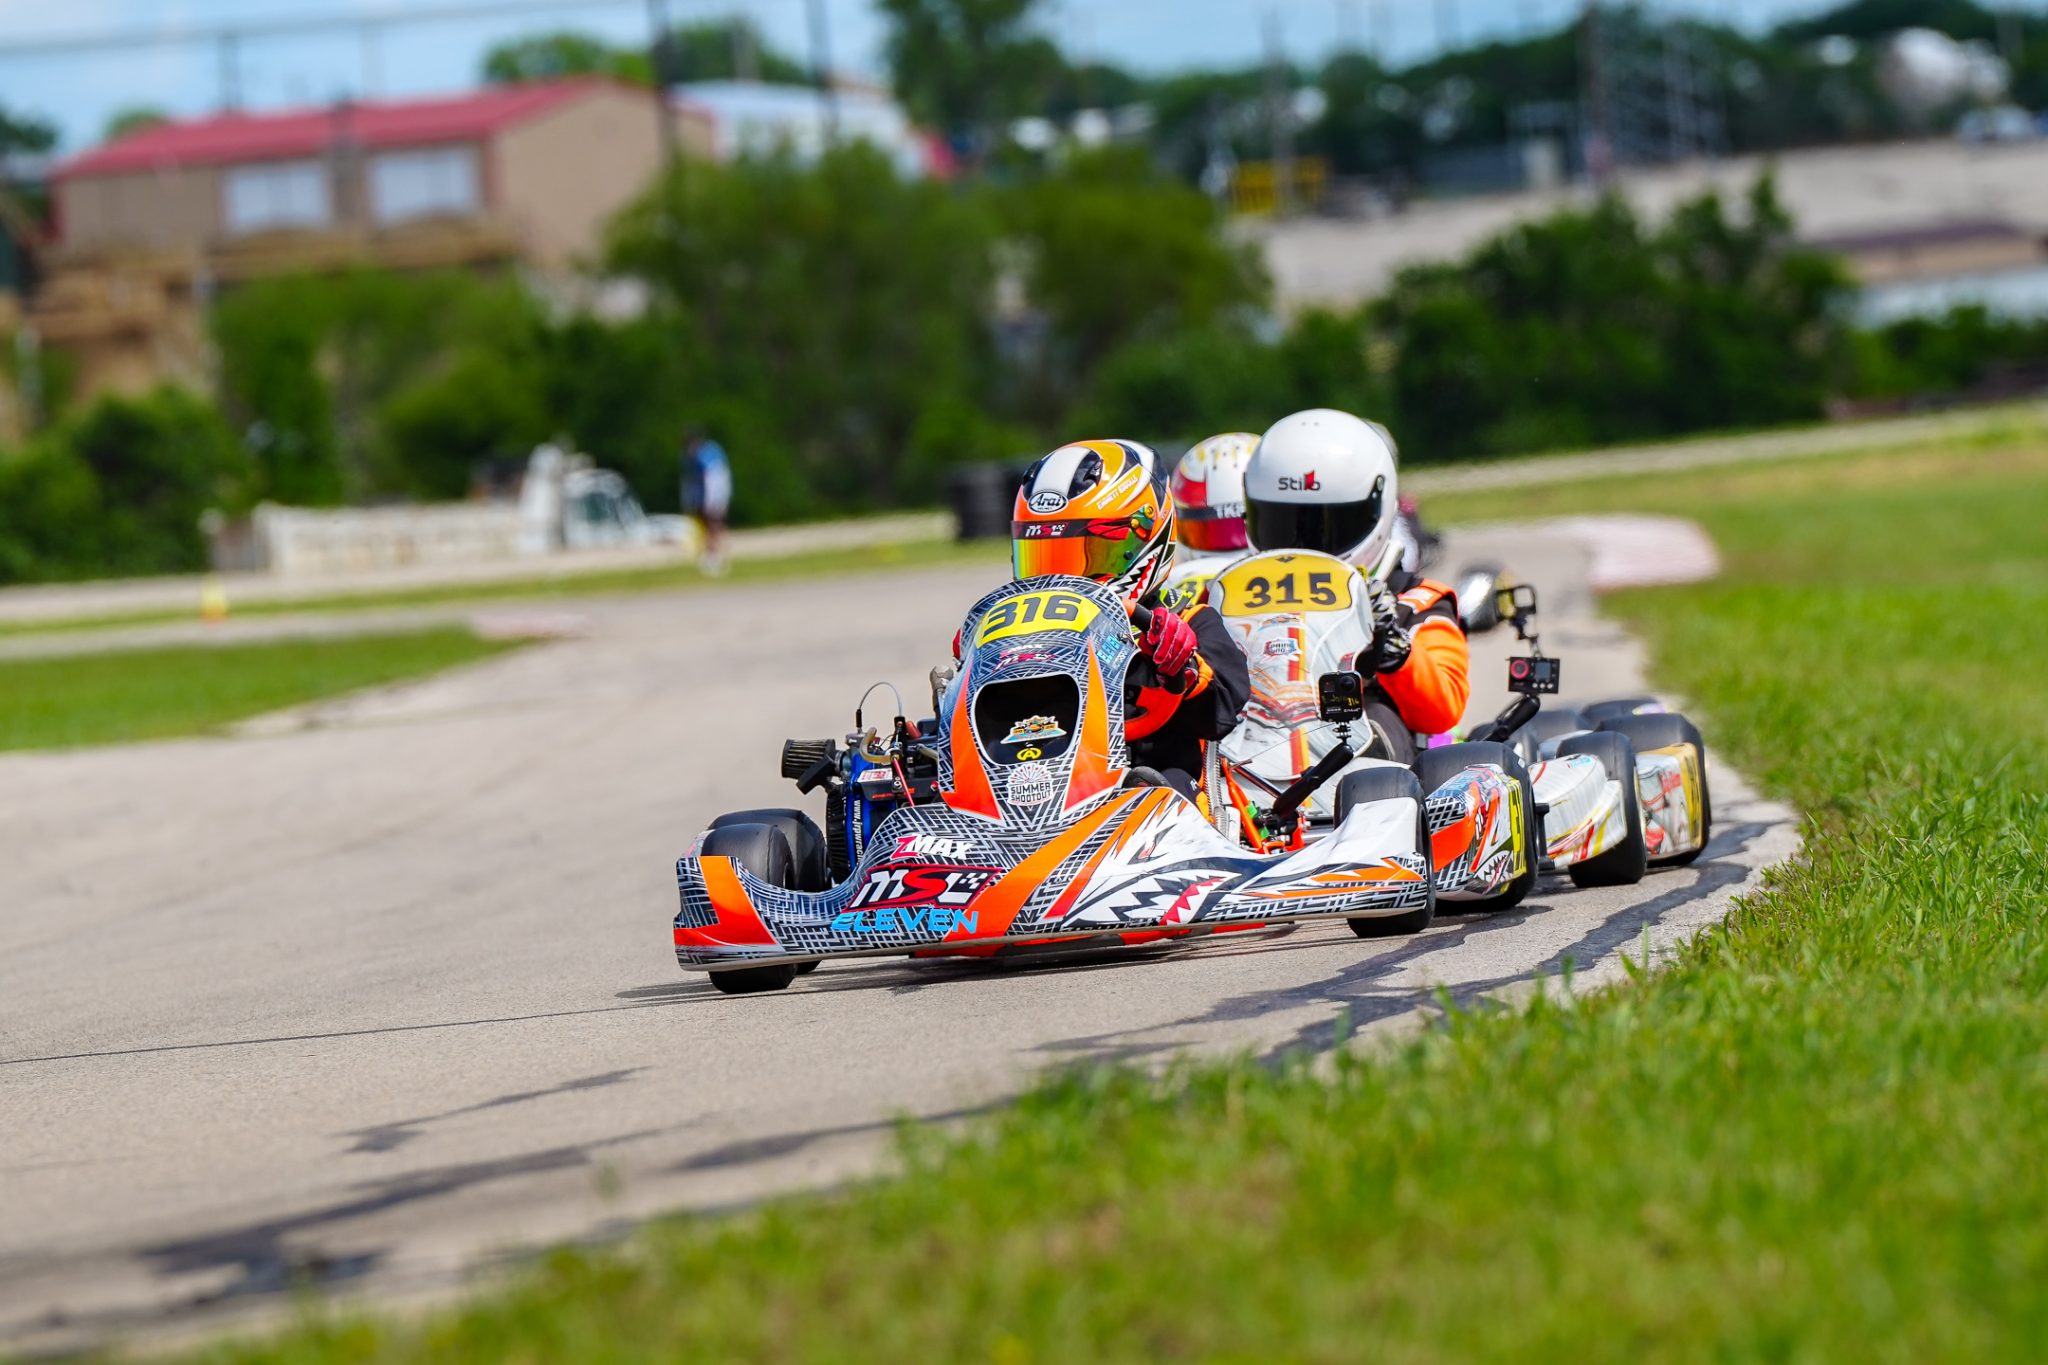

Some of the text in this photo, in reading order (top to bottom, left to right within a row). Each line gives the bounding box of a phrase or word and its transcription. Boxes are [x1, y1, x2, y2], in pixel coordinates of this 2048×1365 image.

[1278, 470, 1321, 491] Stilo
[1030, 493, 1062, 507] Arai
[1244, 572, 1337, 609] 315
[983, 595, 1082, 638] 316
[1010, 782, 1051, 795] SUMMER
[1010, 790, 1051, 803] SHOOTOUT
[891, 833, 977, 860] ZMAX
[831, 907, 979, 934] ELEVEN
